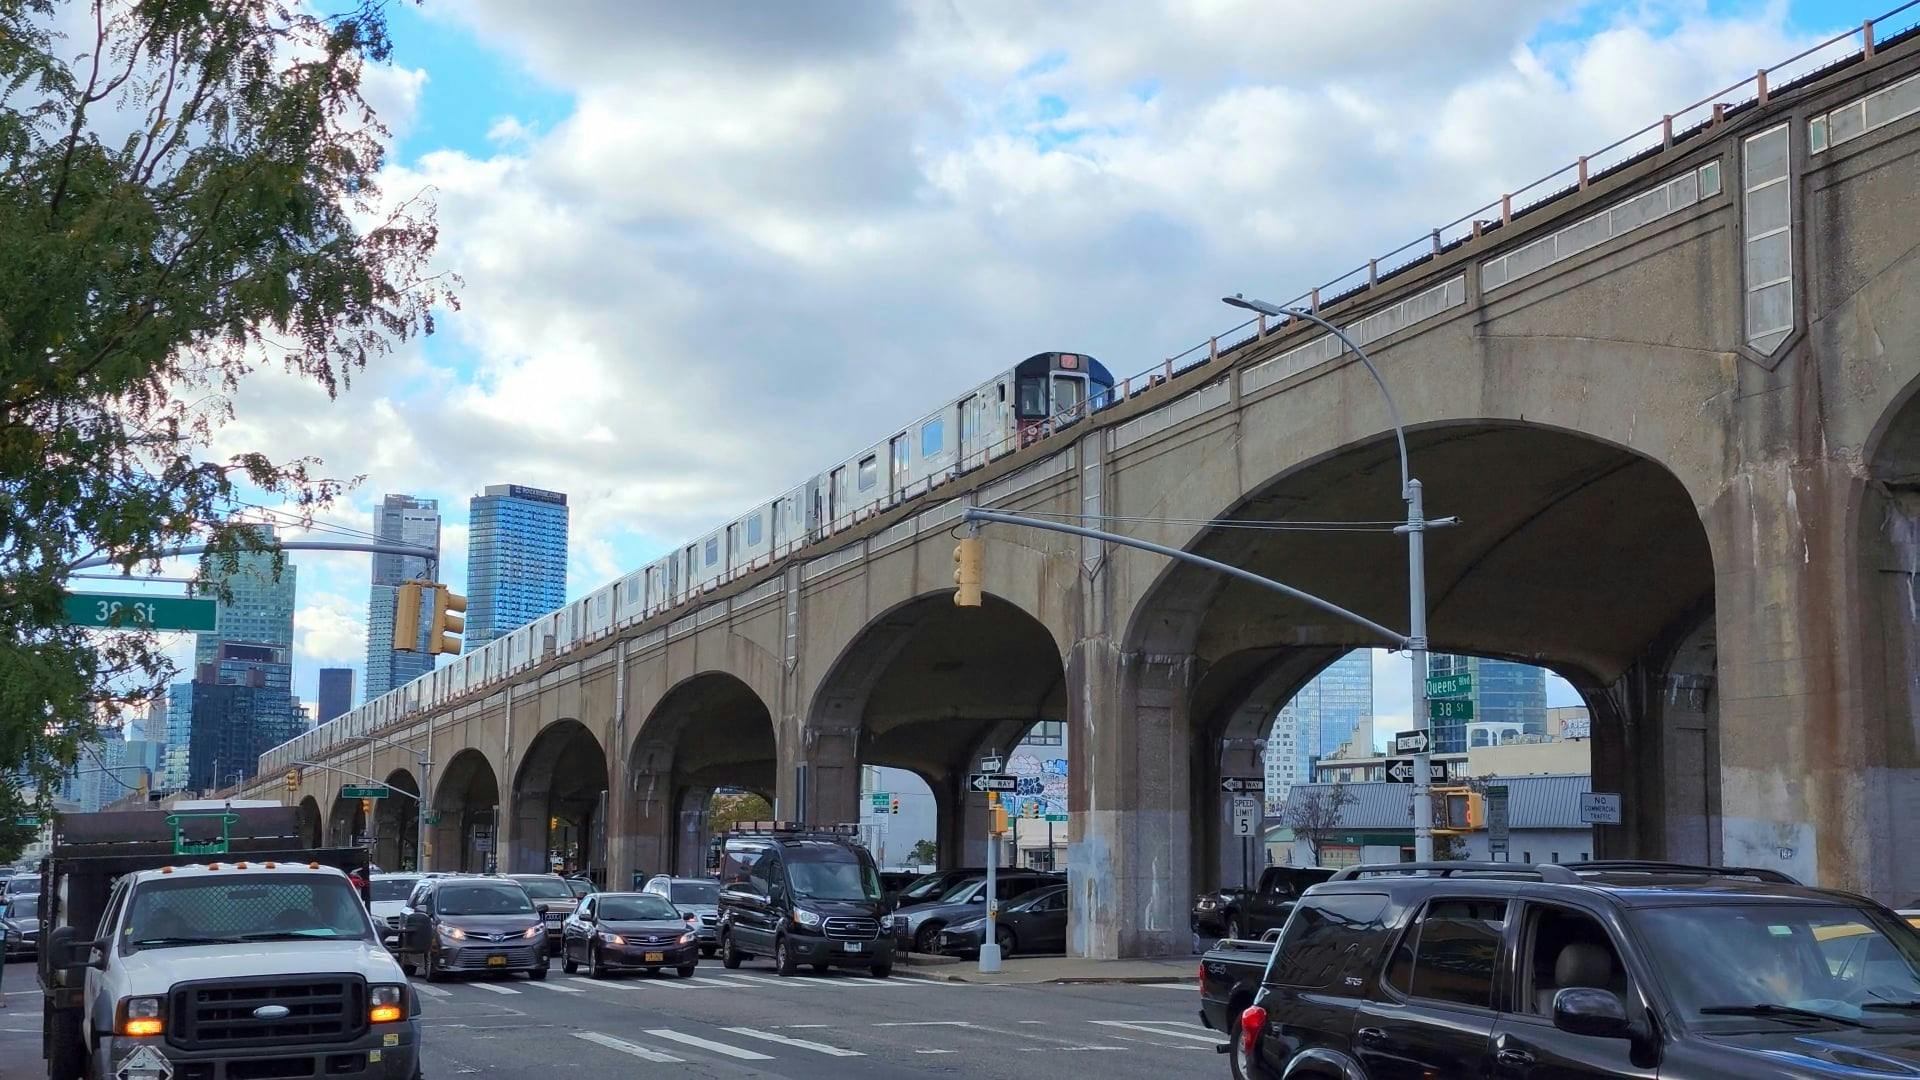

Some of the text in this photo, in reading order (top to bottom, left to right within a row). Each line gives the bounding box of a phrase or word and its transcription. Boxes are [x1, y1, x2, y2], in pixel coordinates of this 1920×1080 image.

[133, 602, 156, 623] St
[1426, 676, 1470, 696] Queens Blvd
[1439, 702, 1464, 716] 38 St
[1394, 766, 1413, 777] ONE
[997, 780, 1012, 788] WAY
[1226, 781, 1260, 789] ONE WAY
[1234, 799, 1254, 808] SPEED
[1594, 796, 1607, 805] NO
[1235, 809, 1253, 817] LIMIT
[1584, 805, 1617, 813] COMMERCIAL
[1240, 818, 1249, 833] 5
